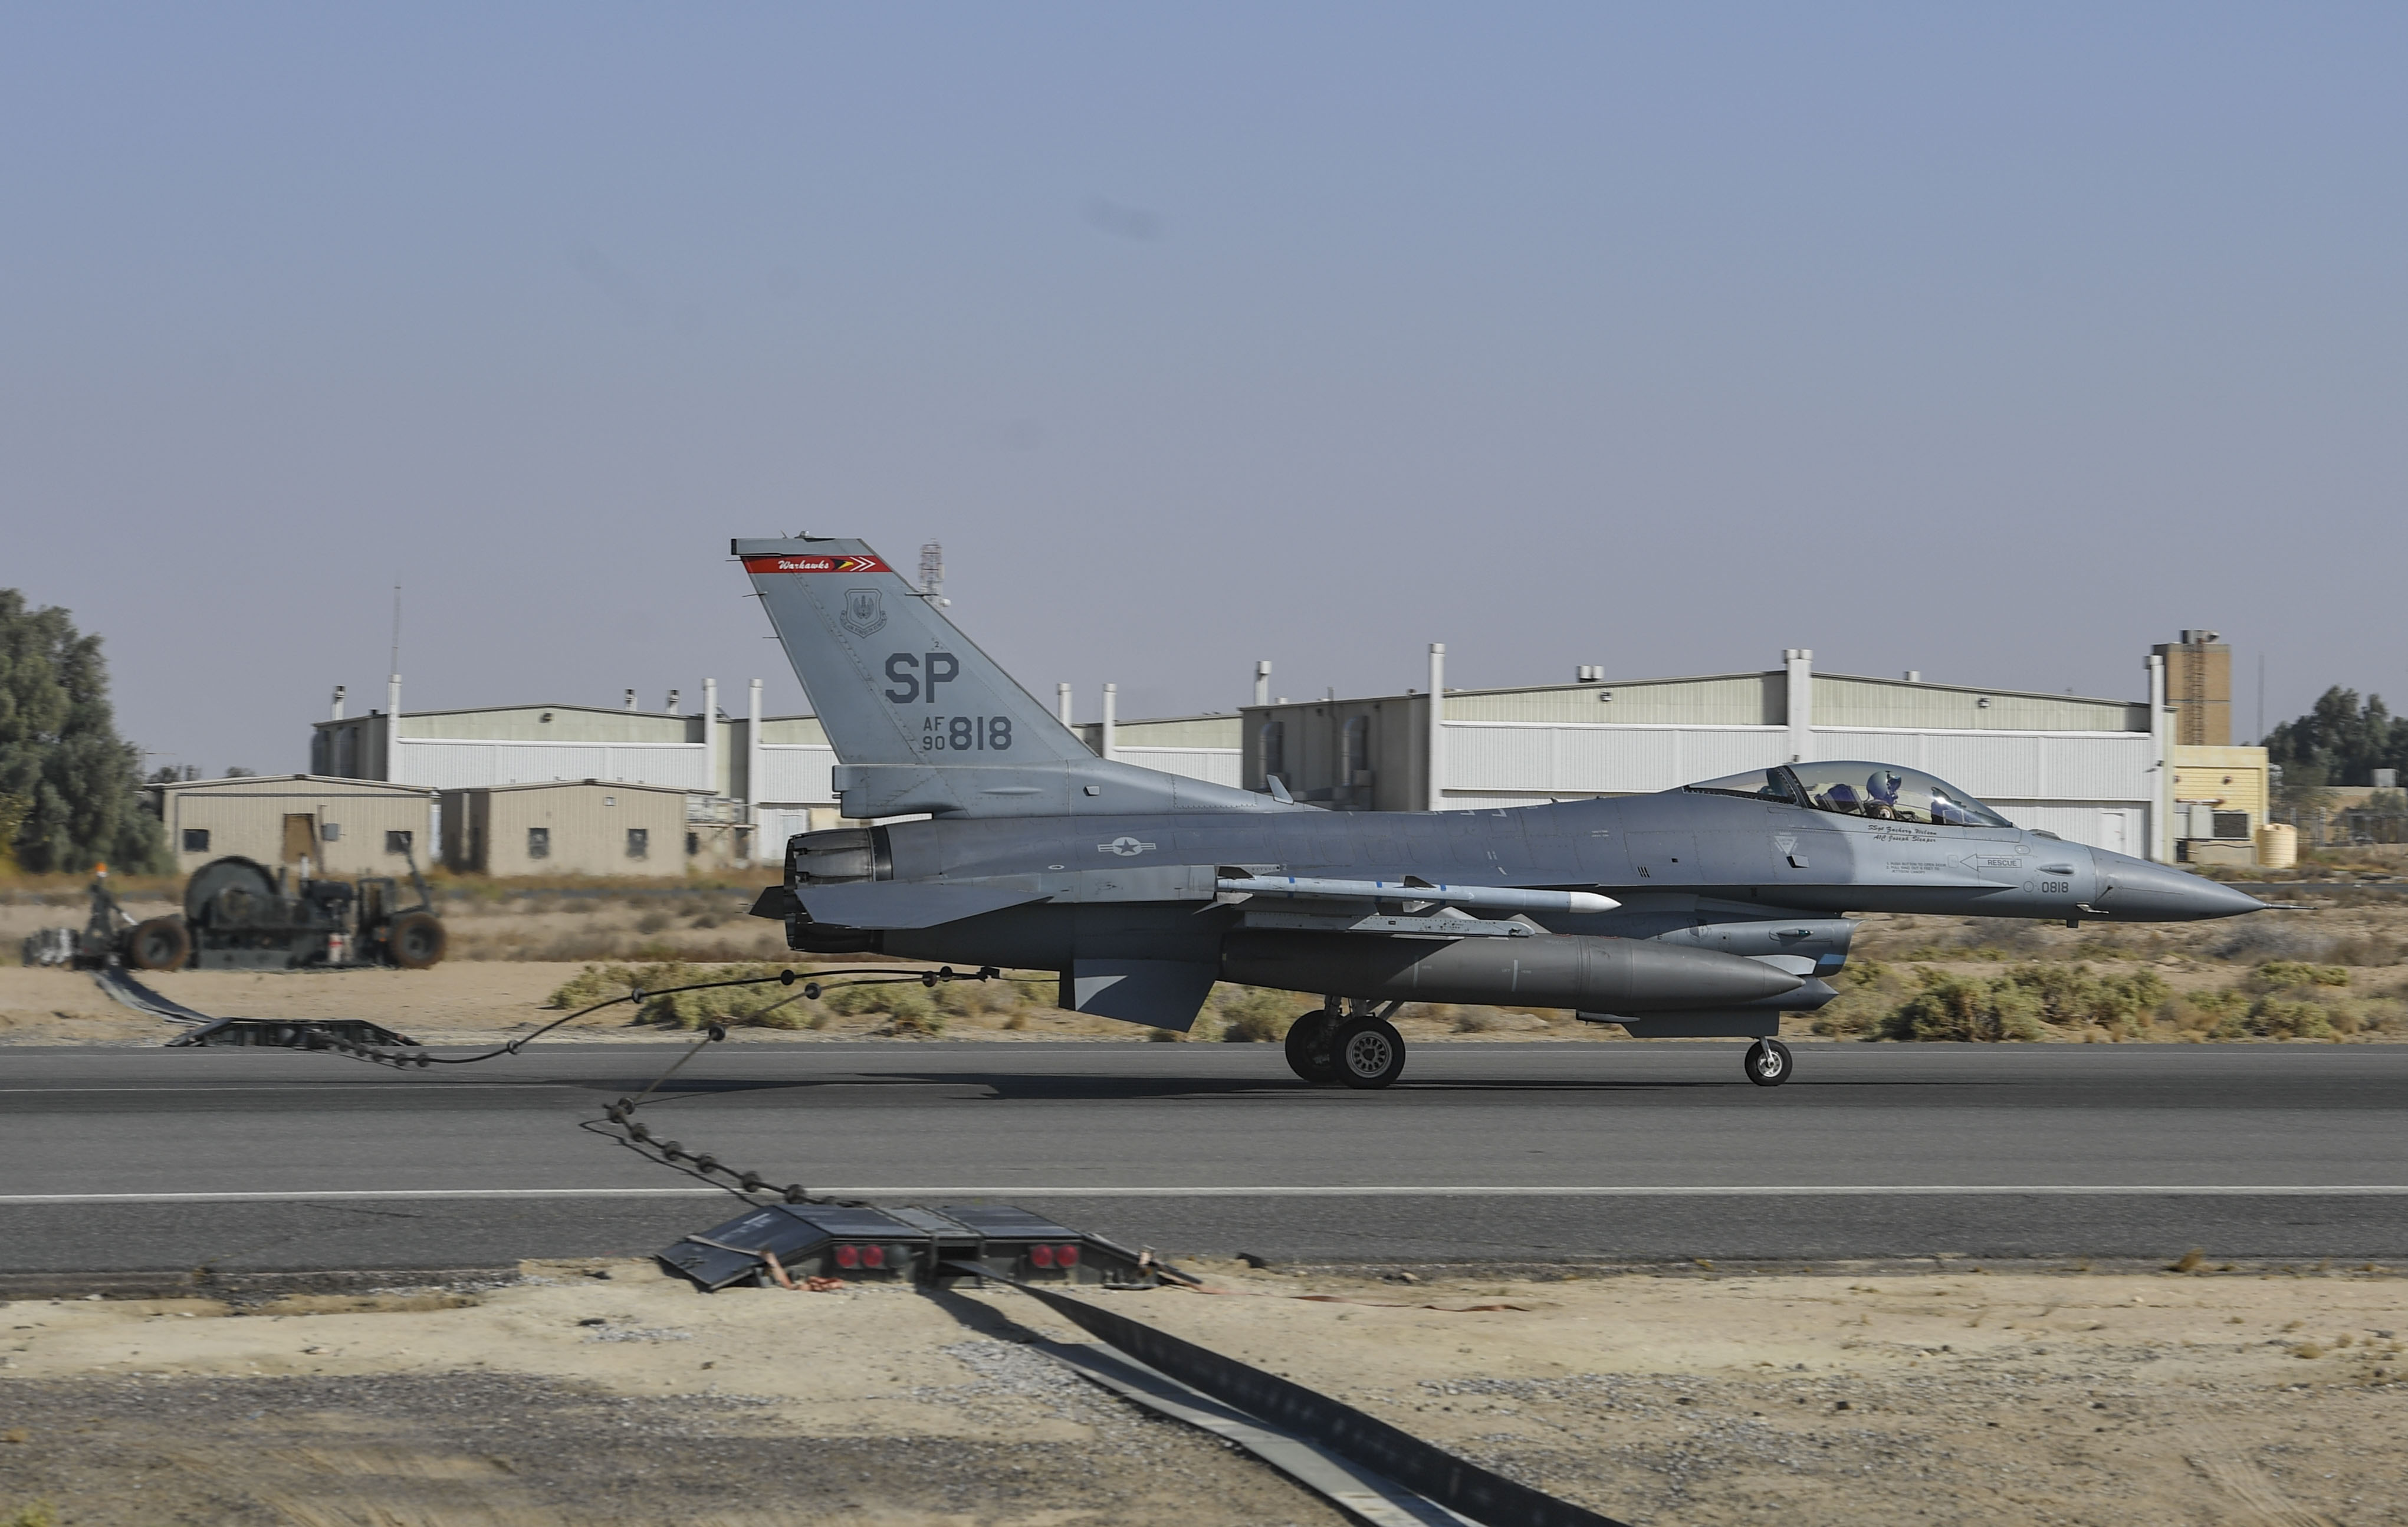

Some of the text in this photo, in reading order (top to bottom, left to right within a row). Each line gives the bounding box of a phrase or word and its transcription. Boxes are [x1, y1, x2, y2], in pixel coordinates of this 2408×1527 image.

[778, 560, 829, 570] Warhawks
[885, 652, 960, 704] SP
[922, 715, 1012, 751] AF 818
[922, 735, 945, 750] 90
[2041, 881, 2069, 893] 0818
